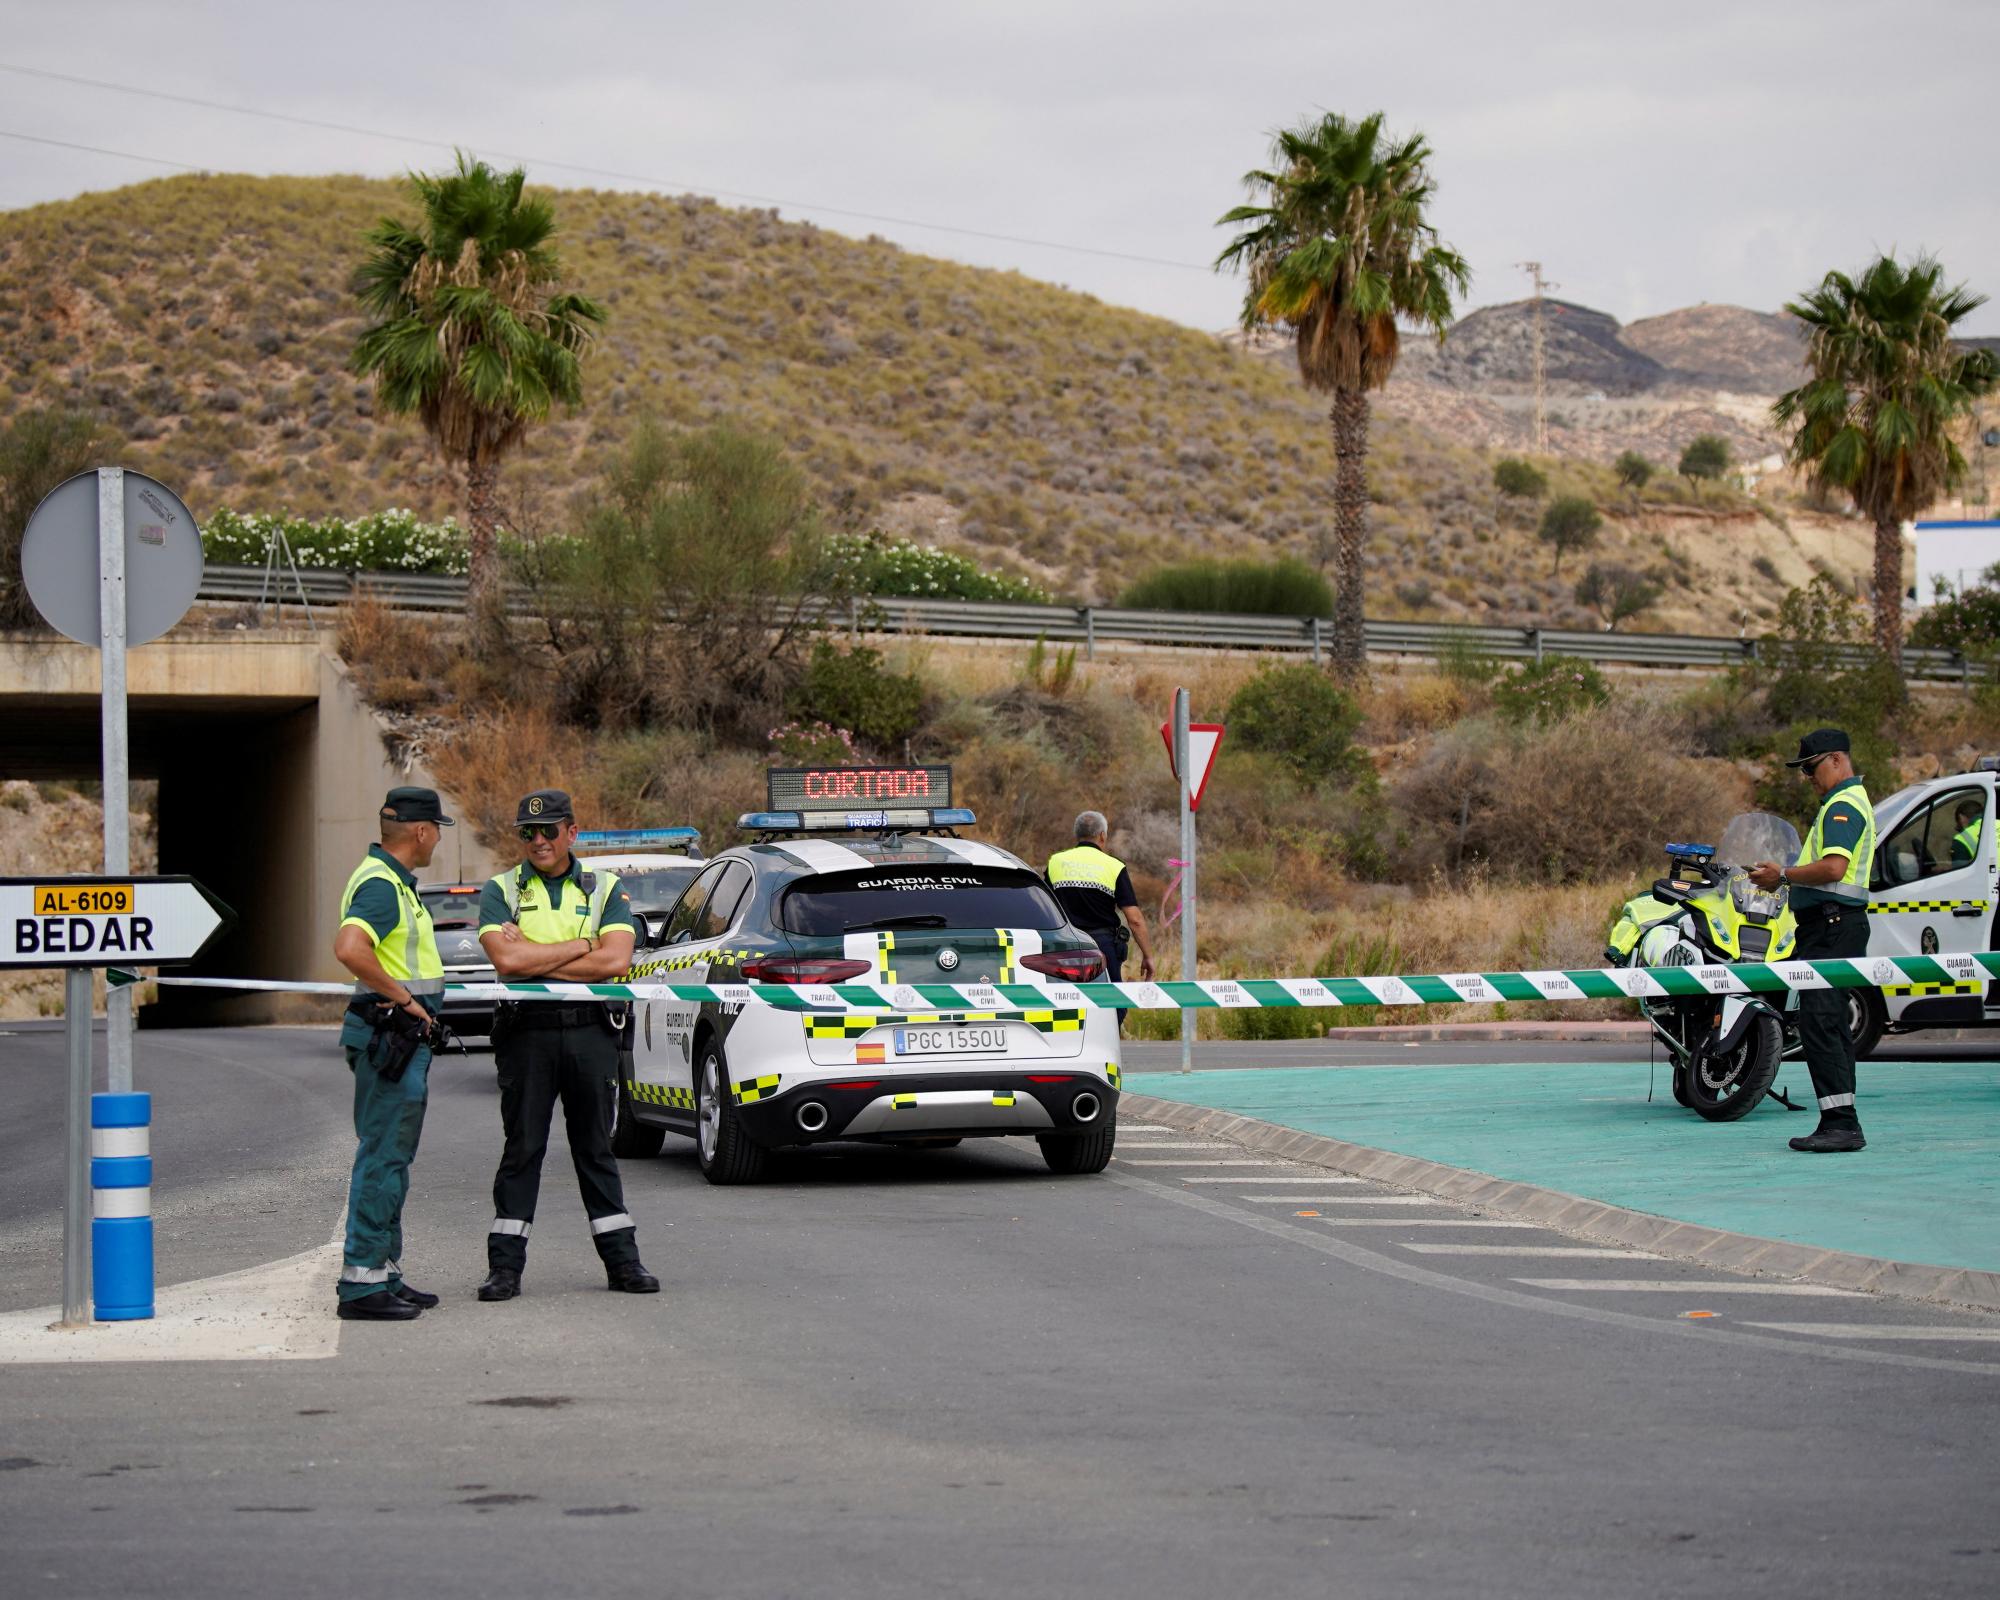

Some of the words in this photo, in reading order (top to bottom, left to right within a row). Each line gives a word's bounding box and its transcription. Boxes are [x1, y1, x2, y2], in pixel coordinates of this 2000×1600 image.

[804, 770, 929, 799] CORTADA
[857, 877, 936, 888] GUARDIA
[940, 877, 983, 886] CIVIL
[42, 891, 127, 911] AL-6109
[1946, 958, 1974, 968] GUARDIA
[1700, 969, 1728, 979] GUARDIA
[1788, 970, 1814, 981] TRAFICO
[1959, 968, 1976, 978] CIVIL
[1455, 978, 1483, 988] GUARDIA
[1543, 980, 1569, 990] TRAFICO
[1713, 980, 1731, 989] CIVIL
[967, 988, 994, 997] GUARDIA
[1211, 984, 1238, 994] GUARDIA
[1299, 988, 1325, 997] TRAFICO
[1468, 988, 1485, 998] CIVIL
[980, 997, 996, 1005] CIVIL
[1054, 992, 1081, 1001] TRAFICO
[1224, 994, 1240, 1003] CIVIL
